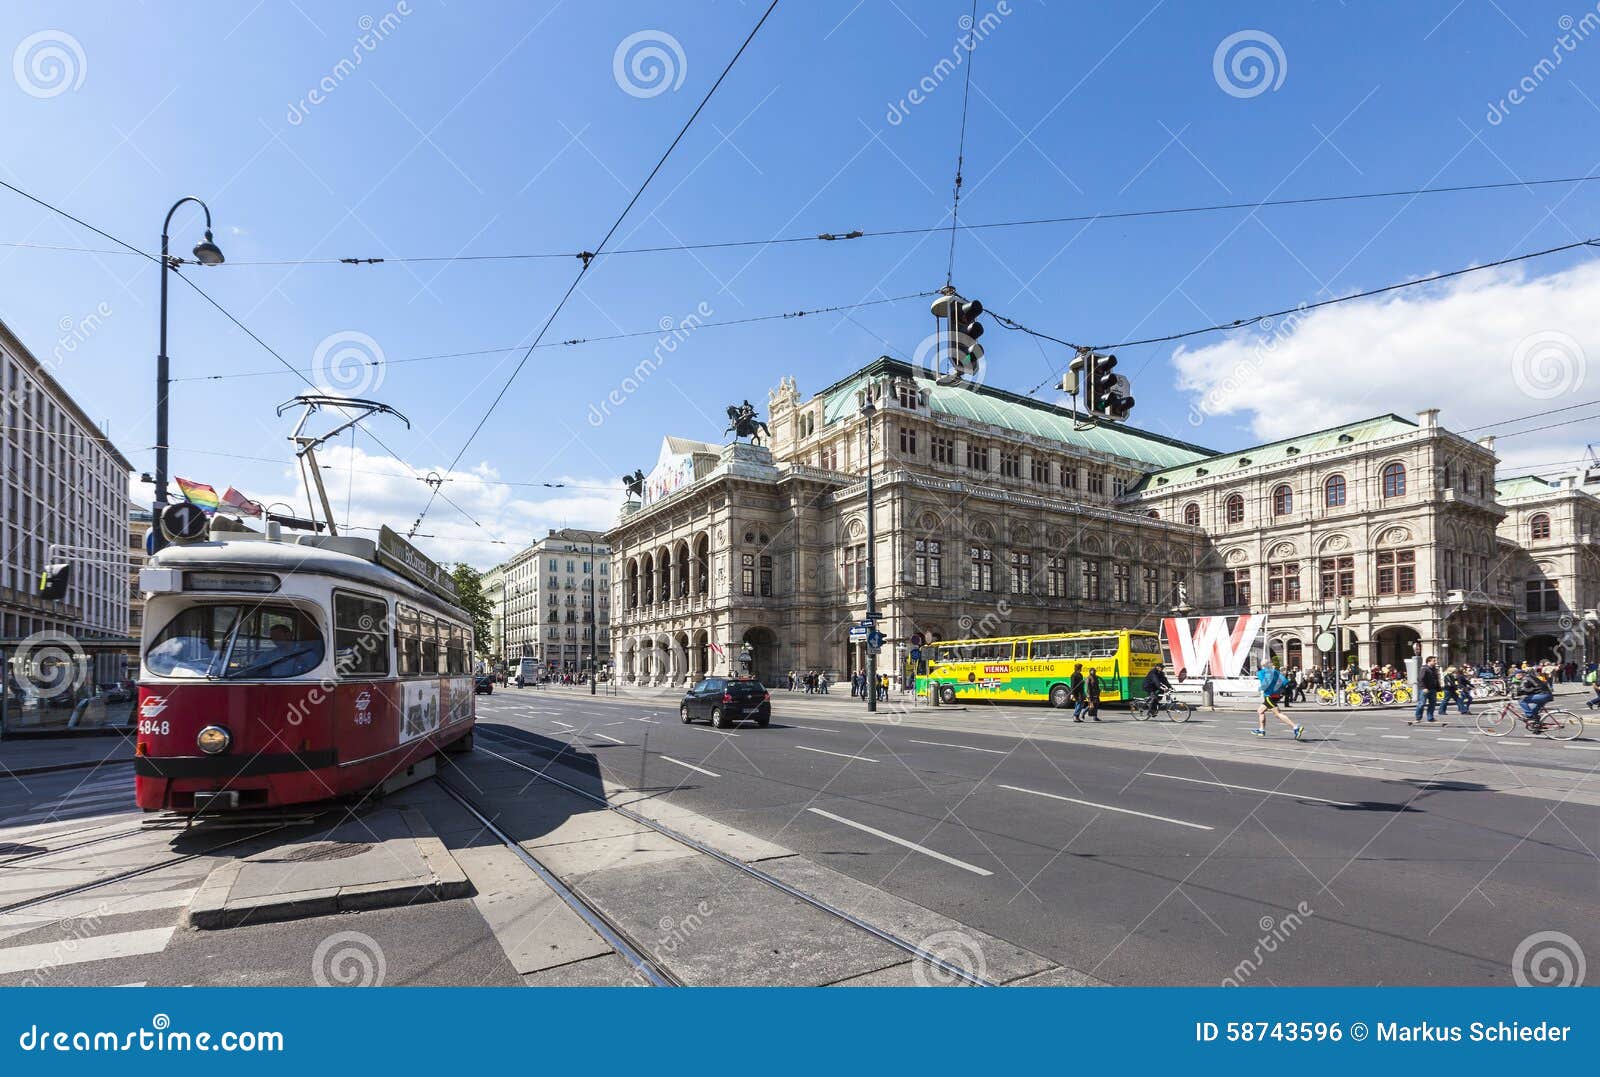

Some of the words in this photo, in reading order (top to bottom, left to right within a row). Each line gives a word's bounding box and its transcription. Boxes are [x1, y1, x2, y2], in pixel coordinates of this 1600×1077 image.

[175, 507, 190, 535] 1
[1164, 615, 1265, 677] W
[139, 720, 170, 735] 4848
[354, 711, 372, 725] 4848
